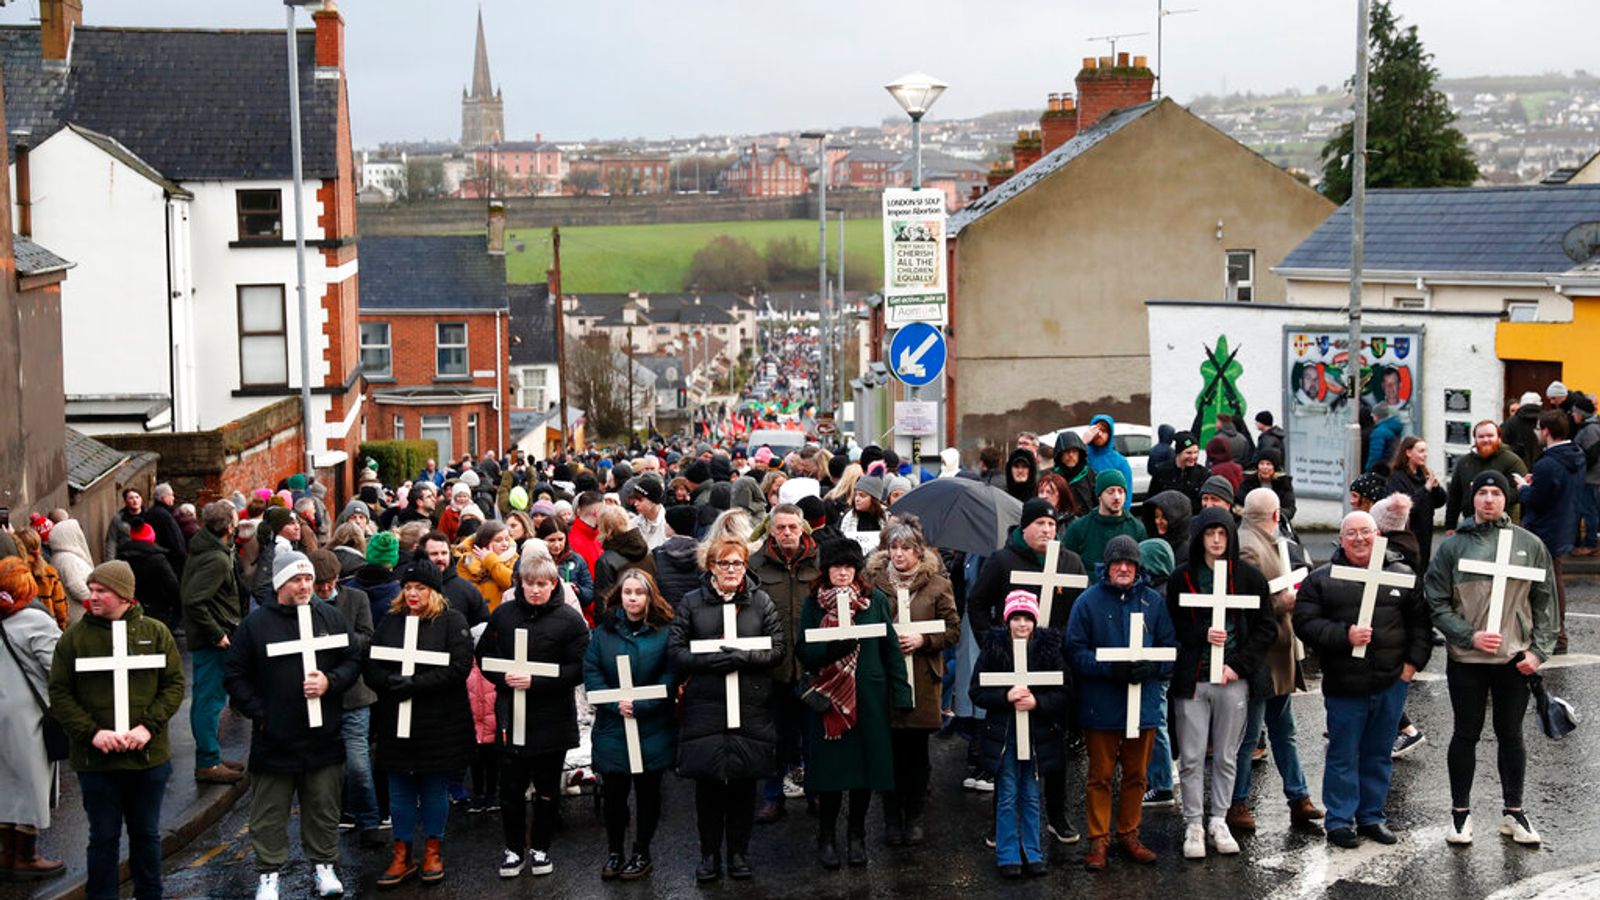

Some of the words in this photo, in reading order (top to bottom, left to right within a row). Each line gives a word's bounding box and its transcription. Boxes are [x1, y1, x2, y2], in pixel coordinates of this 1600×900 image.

[888, 208, 911, 216] Impose
[897, 258, 913, 266] ALL
[916, 258, 934, 266] THE
[890, 296, 900, 304] Get
